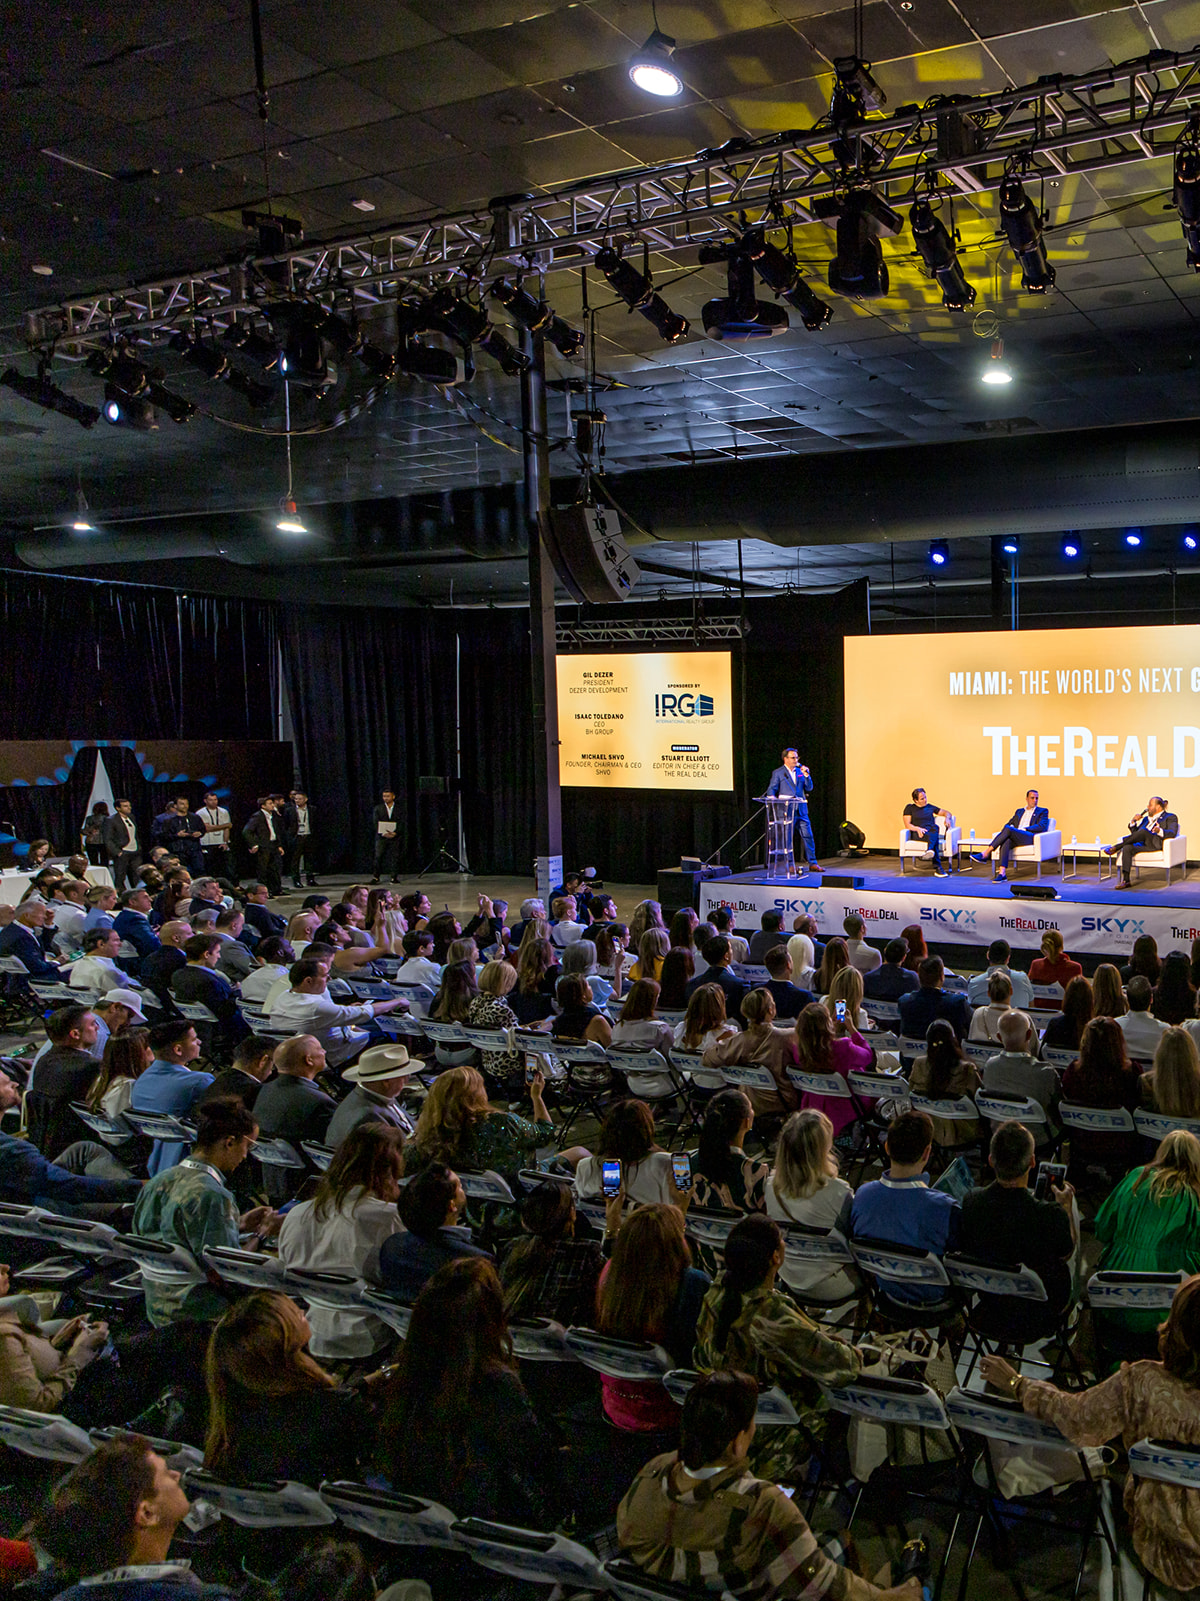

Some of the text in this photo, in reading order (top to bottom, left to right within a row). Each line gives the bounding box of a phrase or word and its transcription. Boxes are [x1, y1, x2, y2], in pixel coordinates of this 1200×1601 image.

[949, 671, 1013, 696] MIAMI:
[1019, 671, 1049, 695] THE
[1138, 667, 1184, 693] NEXT
[655, 693, 695, 717] IRG
[774, 899, 825, 914] SKYX
[920, 907, 977, 924] SKYX
[1081, 917, 1145, 934] SKYX
[672, 1057, 700, 1065] SKY
[1047, 1052, 1078, 1060] SKY
[1061, 1111, 1107, 1122] SKYX
[1134, 1117, 1183, 1129] SKYX
[584, 1210, 606, 1219] SK
[685, 1218, 727, 1234] KYX
[1088, 1286, 1160, 1297] SKYX
